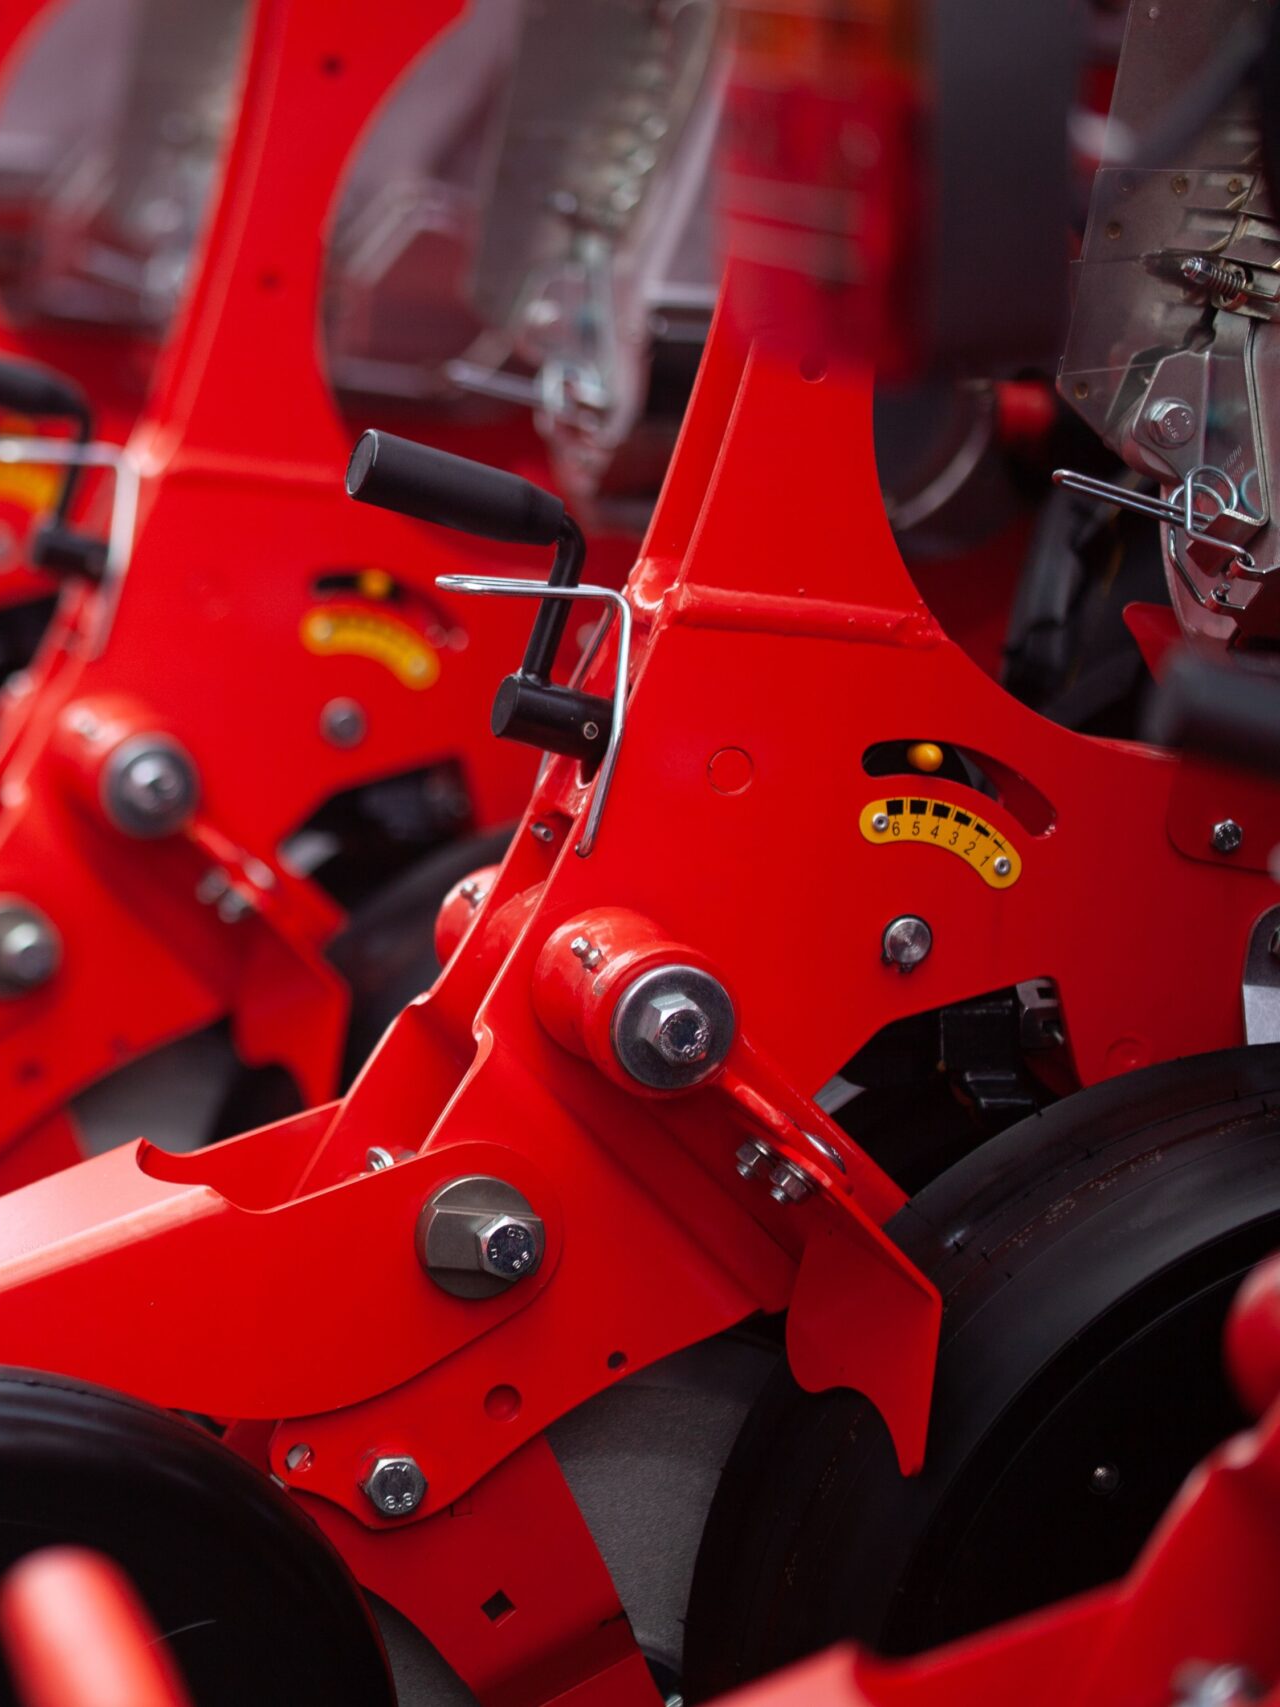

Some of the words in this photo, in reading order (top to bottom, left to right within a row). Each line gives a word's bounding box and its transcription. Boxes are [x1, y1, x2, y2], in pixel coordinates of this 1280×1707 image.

[892, 821, 901, 836] 6
[912, 821, 921, 836] 5
[930, 825, 940, 839] 4
[948, 831, 959, 846] 3
[963, 841, 977, 856] 2
[980, 856, 990, 867] 1
[384, 1492, 414, 1509] 8.8
